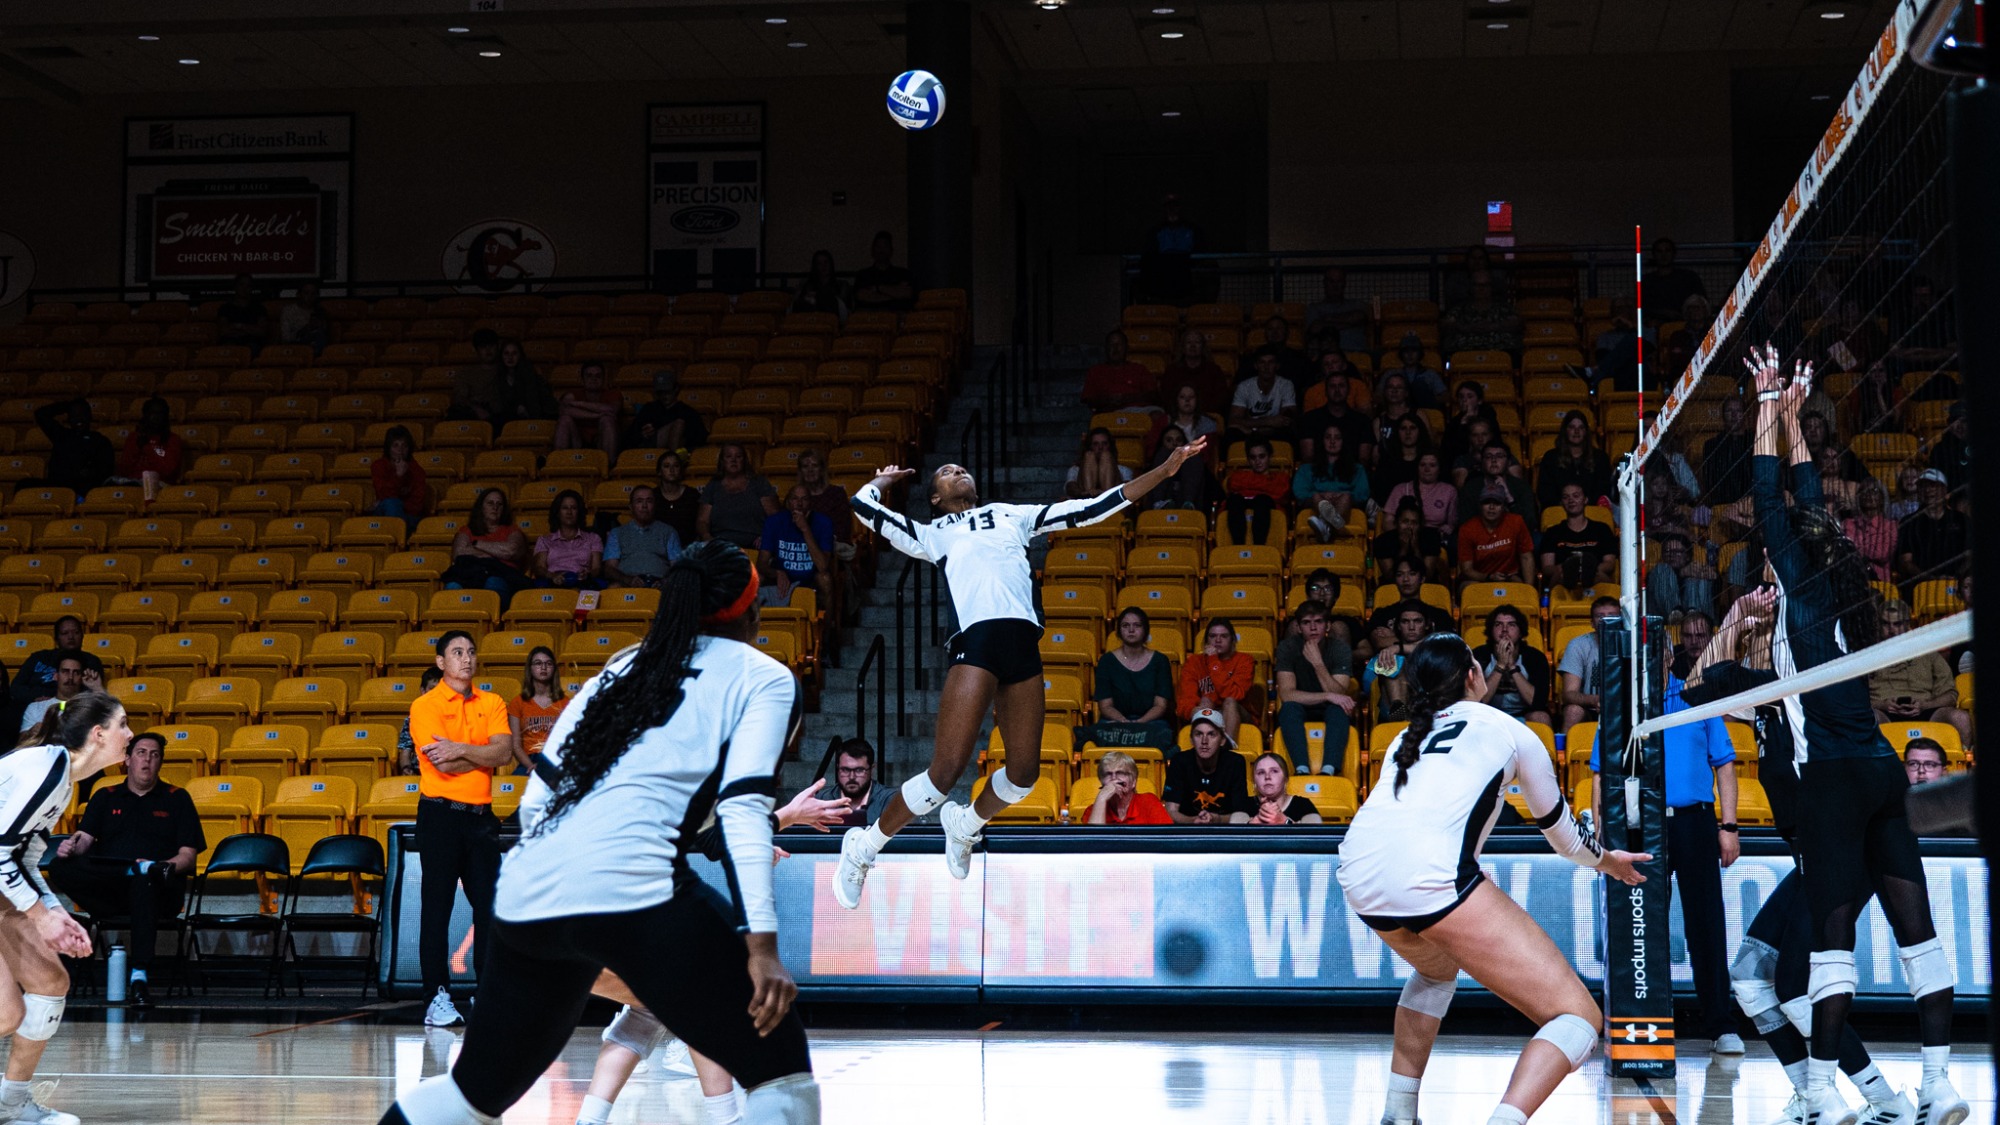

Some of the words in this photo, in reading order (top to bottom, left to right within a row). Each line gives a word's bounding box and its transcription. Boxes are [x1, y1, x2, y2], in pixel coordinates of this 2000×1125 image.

[476, 0, 497, 10] 104
[892, 91, 922, 109] molten
[655, 112, 758, 126] CAMPBELL
[653, 186, 758, 204] PRECISION
[159, 210, 310, 246] Smithfield's
[684, 209, 726, 229] Ford
[177, 252, 228, 263] CHICKEN
[246, 251, 296, 262] BAR-B-Q
[969, 509, 996, 531] 13
[778, 550, 795, 561] BIG
[783, 561, 815, 571] CREW
[1420, 720, 1468, 755] 2
[866, 862, 1105, 973] VISIT
[1629, 887, 1647, 937] sports
[1631, 939, 1649, 999] imports
[1621, 1061, 1638, 1070] (800)
